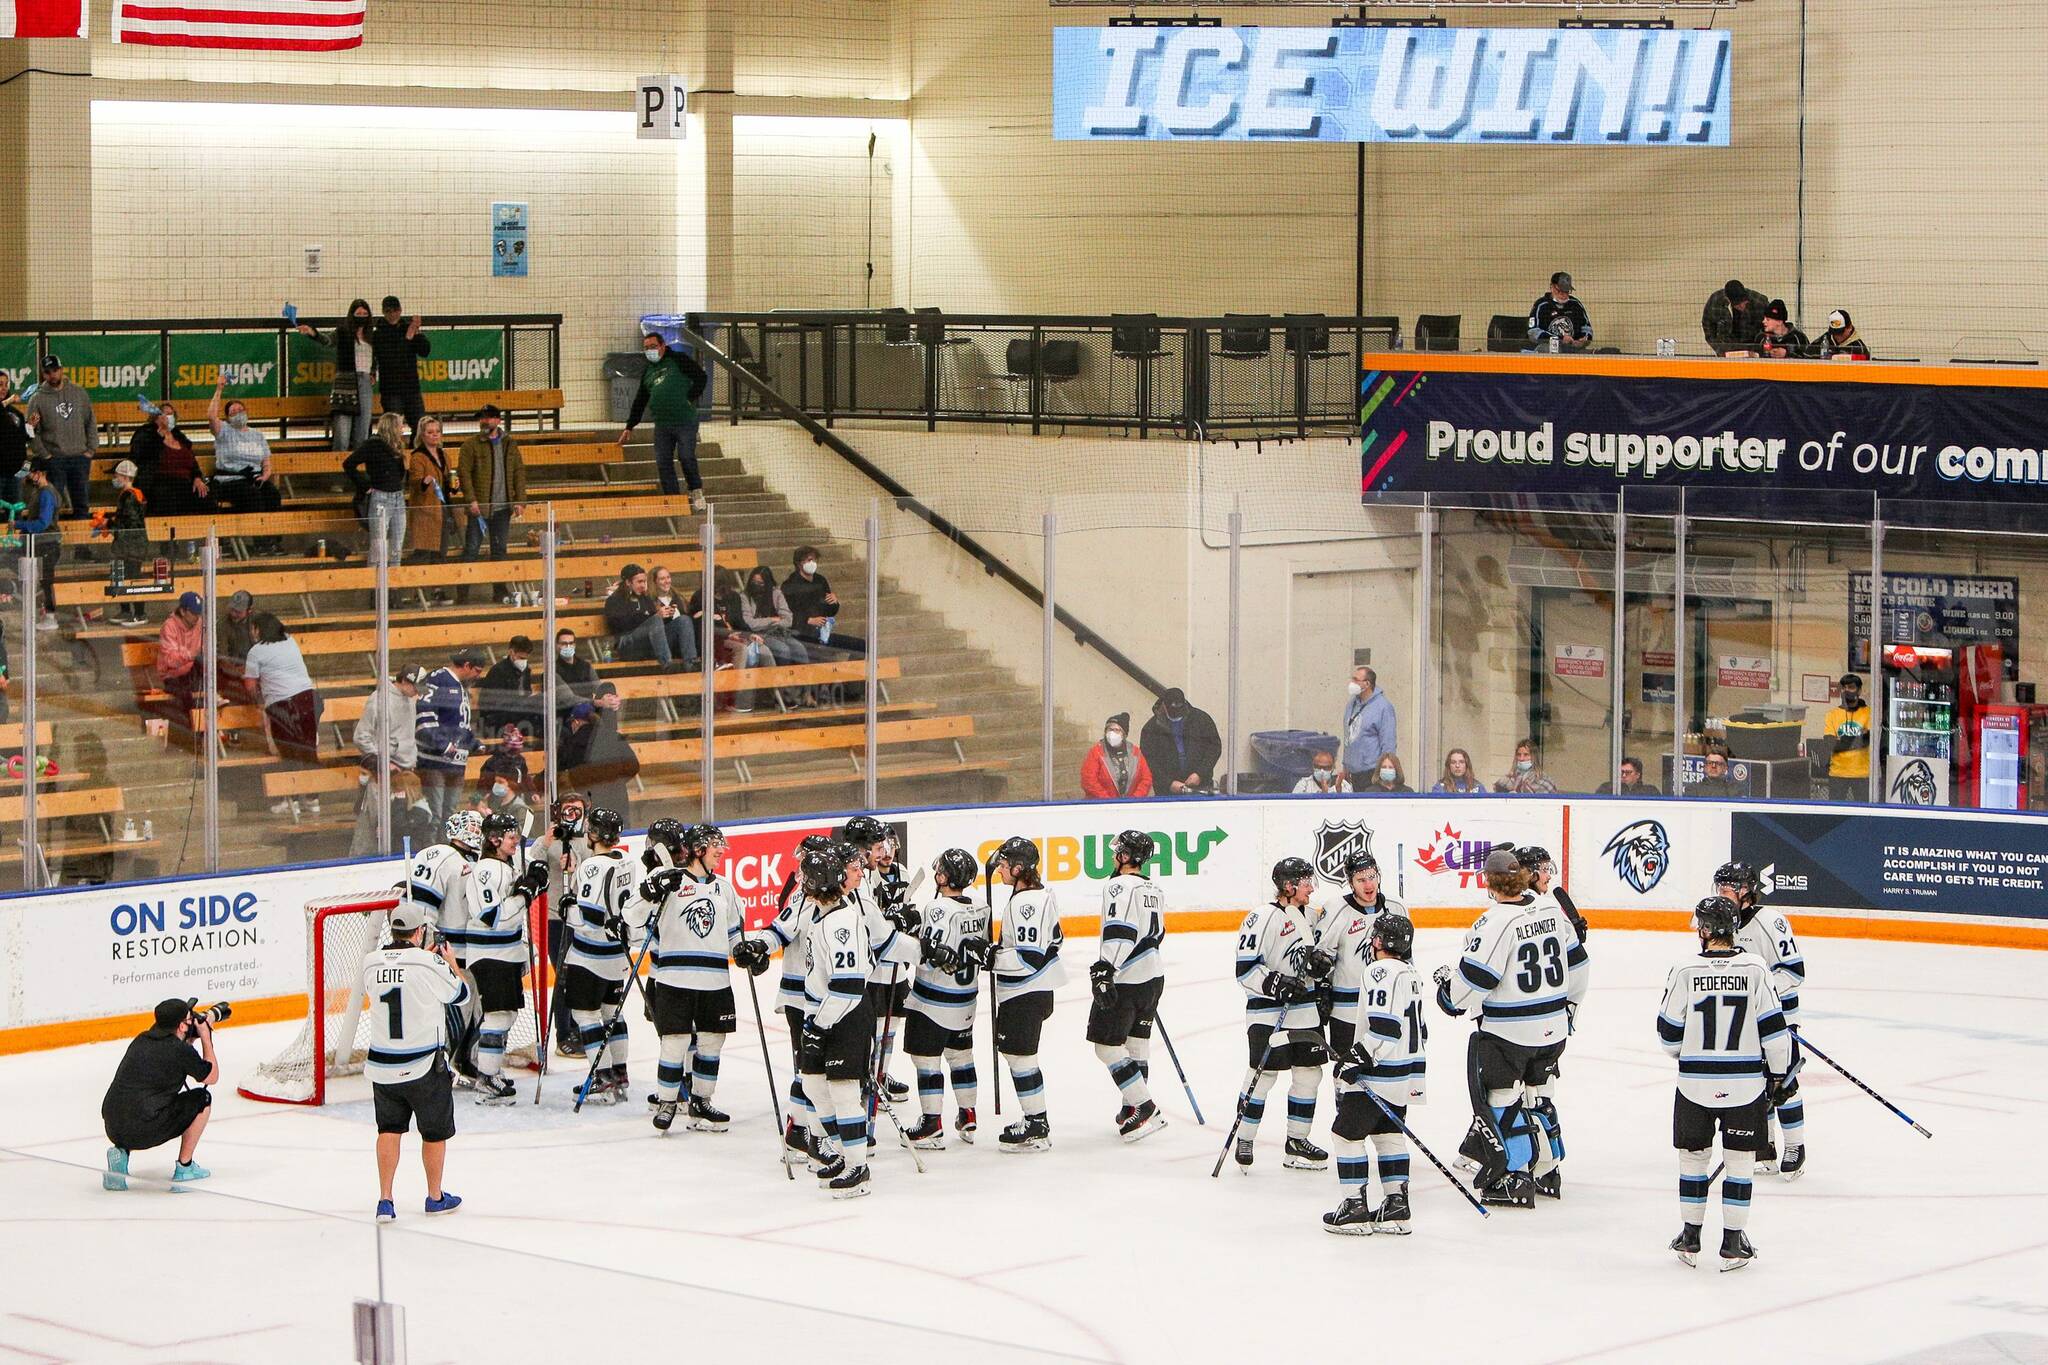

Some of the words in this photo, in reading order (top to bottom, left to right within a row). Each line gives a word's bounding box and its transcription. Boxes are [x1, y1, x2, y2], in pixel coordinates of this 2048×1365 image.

[1082, 27, 1338, 137] ICE
[1370, 28, 1728, 143] WIN!!
[642, 86, 664, 128] P
[674, 86, 685, 128] P
[175, 361, 275, 388] SUBWAY
[293, 362, 337, 385] SUB
[1427, 420, 1553, 462] Proud
[1565, 430, 1787, 478] supporter
[1800, 431, 1847, 472] of
[1853, 443, 1928, 475] our
[1936, 444, 2048, 484] com
[1893, 577, 1948, 597] COLD
[1953, 580, 2014, 599] BEER
[1854, 594, 1895, 605] SPITS
[1907, 597, 1936, 607] WINE
[1942, 609, 1966, 618] WINE
[1994, 611, 2014, 620] 9.00
[1943, 626, 1975, 635] LIQUOR
[1682, 771, 1704, 783] EER
[975, 826, 1229, 887] SBWAY
[1327, 838, 1363, 872] NHL
[1883, 846, 1895, 855] IT
[1898, 846, 1909, 856] IS
[1912, 847, 1963, 859] AMAZING
[1966, 850, 1998, 861] WHAT
[2000, 852, 2023, 862] YOU
[2026, 853, 2048, 864] CAN
[414, 863, 432, 881] 31
[725, 853, 783, 889] ICK
[1883, 859, 1956, 871] ACCOMPLISH
[1959, 863, 1970, 871] IF
[1972, 863, 1995, 873] YOU
[1998, 865, 2014, 875] DO
[2016, 866, 2040, 877] NOT
[715, 882, 720, 895] A
[1775, 875, 1808, 886] SMS
[1883, 871, 1913, 882] CARE
[1916, 874, 1942, 884] WHO
[1945, 875, 1975, 886] GETS
[1977, 877, 2000, 887] THE
[2002, 878, 2044, 890] CREDIT.
[483, 889, 493, 904] 9
[581, 884, 592, 898] 8
[1883, 887, 1904, 895] HARRY
[741, 896, 757, 908] ou
[1107, 902, 1117, 918] 4
[111, 901, 165, 936] ON
[1018, 926, 1037, 943] 39
[1515, 917, 1557, 941] ALEXANDER
[112, 927, 257, 961] RESTORATION
[1239, 934, 1257, 950] 24
[1778, 937, 1798, 957] 21
[835, 951, 856, 969] 28
[1516, 936, 1564, 993] 33
[112, 967, 180, 985] Performance
[183, 958, 260, 978] demonstrated.
[376, 967, 405, 985] LEITE
[207, 977, 236, 991] Every
[239, 975, 260, 989] day.
[1693, 975, 1748, 992] PEDERSON
[1367, 989, 1387, 1007] 18
[379, 986, 405, 1040] 1
[1693, 995, 1749, 1051] 17
[825, 1059, 844, 1067] CCM
[1474, 1115, 1504, 1153] CCM
[1727, 1127, 1755, 1136] CCM
